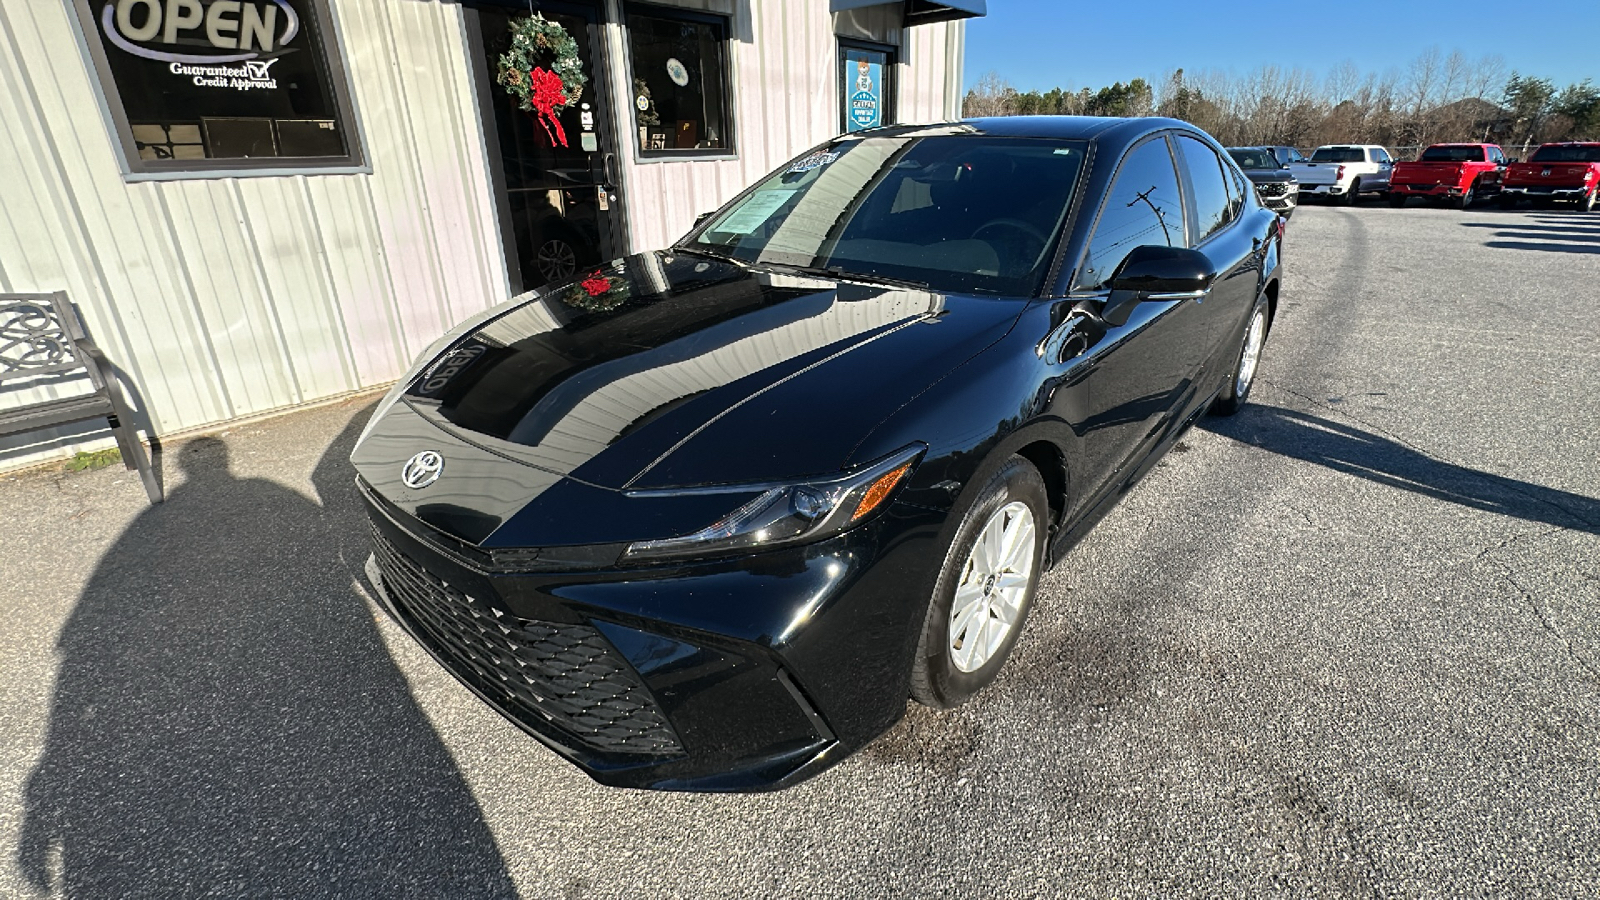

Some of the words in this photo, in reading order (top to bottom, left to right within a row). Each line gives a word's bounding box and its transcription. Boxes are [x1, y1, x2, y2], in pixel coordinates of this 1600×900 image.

[117, 0, 277, 52] OPEN
[169, 62, 248, 77] Guaranteed
[193, 76, 228, 87] Credit
[229, 78, 277, 90] Approval
